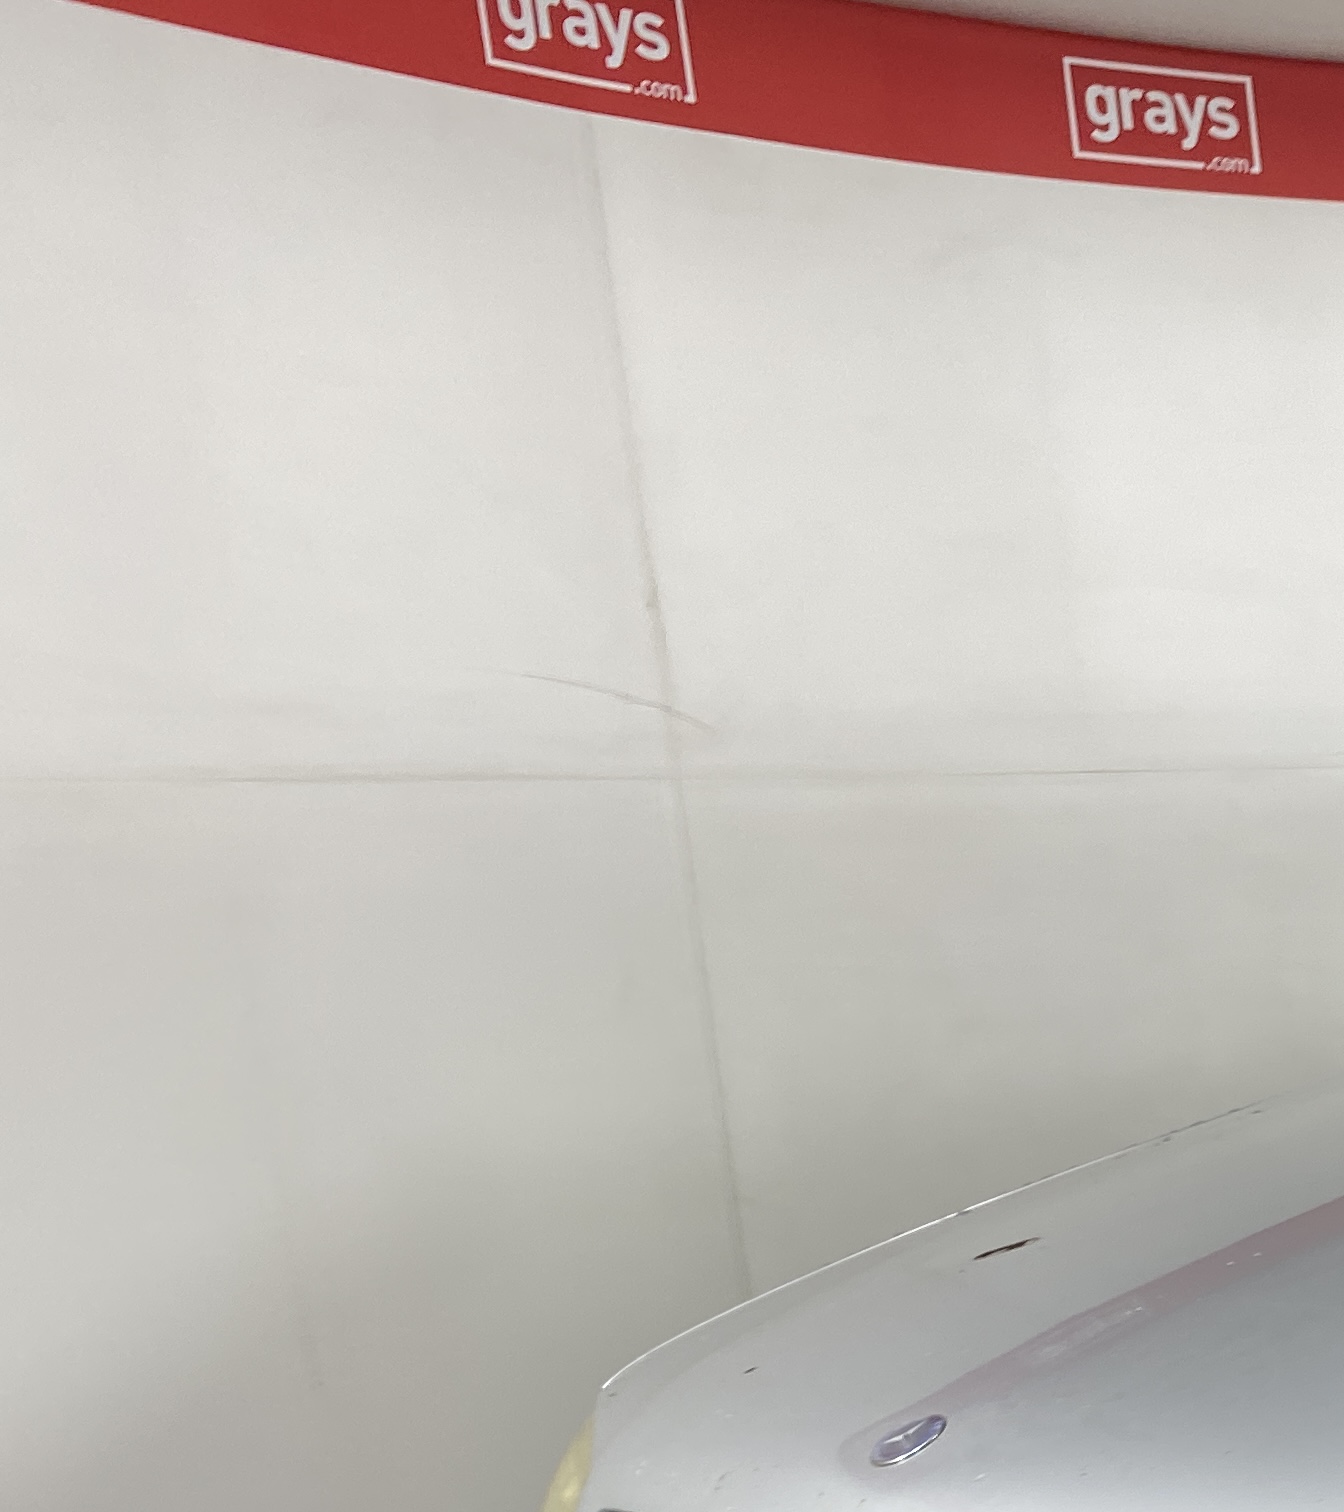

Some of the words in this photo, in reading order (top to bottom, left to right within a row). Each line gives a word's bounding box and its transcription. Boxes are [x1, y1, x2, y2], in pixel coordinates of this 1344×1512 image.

[498, 0, 669, 69] grays
[634, 80, 683, 102] .com
[1085, 84, 1240, 150] grays
